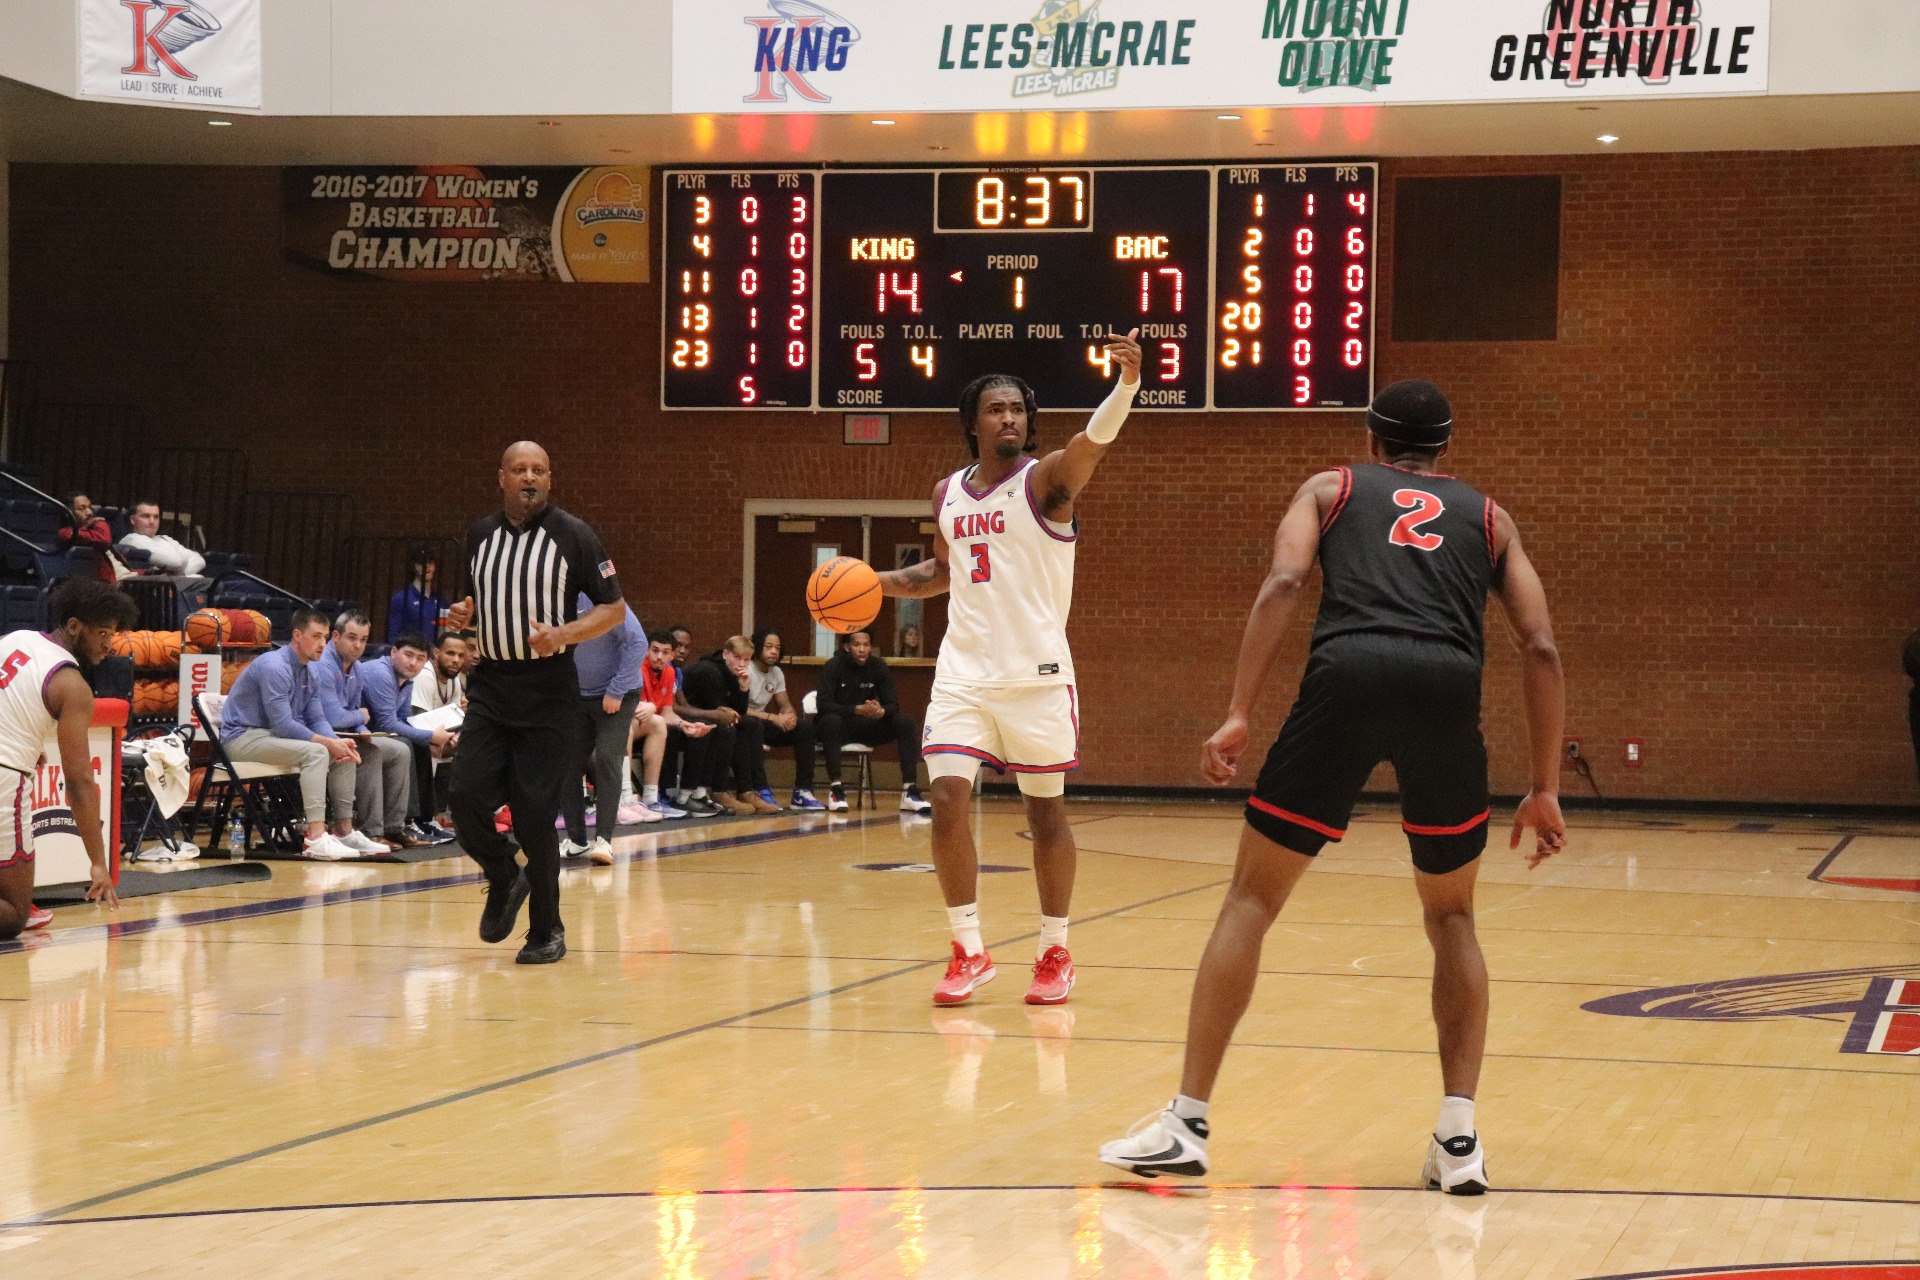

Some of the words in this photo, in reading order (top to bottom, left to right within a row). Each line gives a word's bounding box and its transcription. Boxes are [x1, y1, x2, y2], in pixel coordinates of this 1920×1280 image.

[1262, 0, 1409, 39] MOUNT
[1547, 0, 1693, 30] NORTH
[754, 27, 851, 72] KING
[938, 19, 1197, 70] LEES-MCRAE
[1490, 26, 1755, 81] GREENVILLE
[1278, 39, 1398, 87] OLIVE
[120, 80, 142, 92] LEAD
[152, 82, 178, 95] SERVE
[187, 85, 223, 98] ACHIEVE
[1015, 69, 1116, 95] LEES-McRAE
[311, 175, 429, 199] 2016-2017
[433, 175, 538, 199] WOMEN'S
[677, 174, 706, 189] PLYR
[731, 174, 751, 189] FLS
[777, 173, 799, 188] PTS
[1229, 168, 1260, 184] PLYR
[1285, 168, 1307, 183] FLS
[1335, 167, 1359, 182] PTS
[695, 196, 710, 223] 3
[742, 196, 758, 223] 0
[792, 196, 806, 223] 3
[976, 176, 1083, 225] 8:37
[1255, 193, 1263, 217] 1
[1307, 193, 1314, 216] 1
[1348, 193, 1366, 215] 4
[347, 202, 499, 229] BASKETBALL
[577, 208, 644, 221] CAROLINAS
[328, 230, 521, 270] CHAMPION
[693, 234, 710, 257] 4
[751, 234, 758, 257] 1
[790, 232, 806, 259] 0
[851, 237, 915, 260] KING
[1115, 236, 1169, 259] BAC
[1244, 228, 1263, 256] 2
[1296, 228, 1313, 255] 0
[1347, 227, 1365, 255] 6
[987, 255, 1039, 270] PERIOD
[683, 270, 709, 293] 11
[741, 268, 757, 295] 0
[791, 268, 806, 295] 3
[1141, 267, 1183, 312] 17
[1243, 265, 1262, 293] 5
[1295, 265, 1312, 292] 0
[1346, 264, 1364, 292] 0
[878, 272, 919, 313] 14
[1014, 276, 1024, 309] 1
[683, 304, 709, 331] 13
[750, 306, 757, 328] 1
[789, 304, 805, 331] 2
[1222, 302, 1261, 330] 20
[1294, 302, 1312, 329] 0
[1345, 301, 1363, 329] 2
[840, 325, 885, 339] FOULS
[902, 325, 943, 339] T.O.L.
[958, 324, 1014, 339] PLAYER
[1027, 324, 1064, 339] FOUL
[1141, 324, 1187, 339] FOULS
[672, 340, 709, 367] 23
[750, 342, 757, 364] 1
[788, 340, 804, 367] 0
[856, 343, 877, 379] 5
[911, 345, 934, 378] 4
[1089, 345, 1111, 378] 4
[1160, 343, 1180, 380] 3
[1221, 339, 1260, 367] 21
[1294, 339, 1311, 366] 0
[1345, 339, 1362, 366] 0
[740, 376, 756, 402] 5
[837, 389, 883, 404] SCORE
[1139, 390, 1187, 405] SCORE
[1295, 376, 1310, 403] 3
[853, 417, 880, 440] EXIT
[953, 510, 1006, 540] KING
[1389, 489, 1446, 551] 2
[970, 543, 991, 584] 3
[0, 649, 32, 690] 5
[190, 661, 209, 730] Wiln
[31, 819, 49, 829] ORTS
[50, 817, 77, 827] BISTREA
